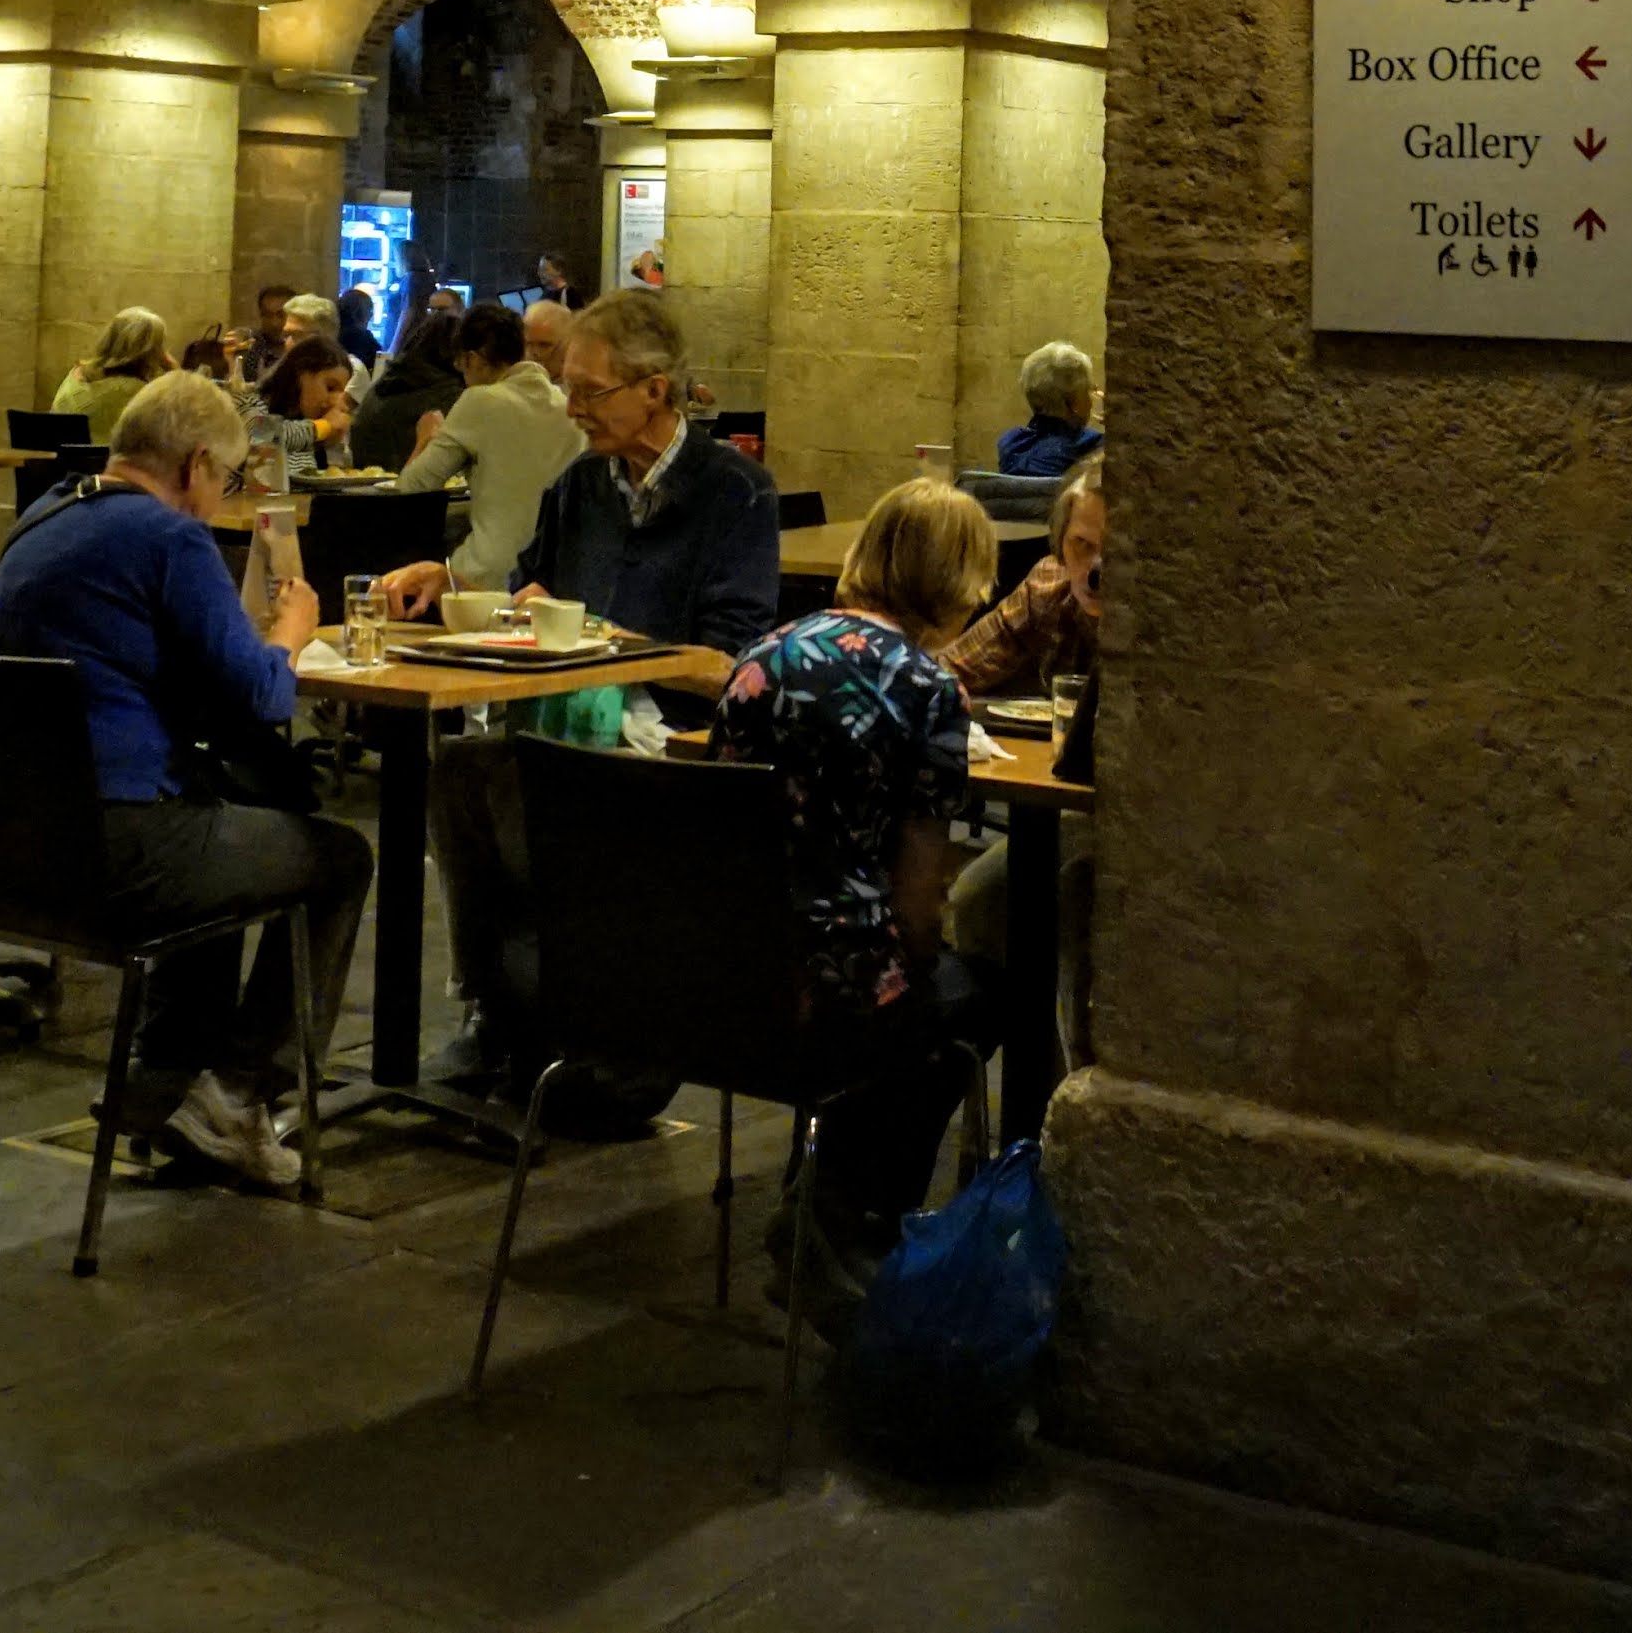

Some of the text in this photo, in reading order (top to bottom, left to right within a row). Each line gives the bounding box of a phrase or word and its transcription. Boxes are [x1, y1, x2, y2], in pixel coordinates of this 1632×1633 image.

[1347, 44, 1541, 82] Box Office
[1403, 121, 1542, 170] Gallery
[1409, 200, 1540, 240] Toilets
